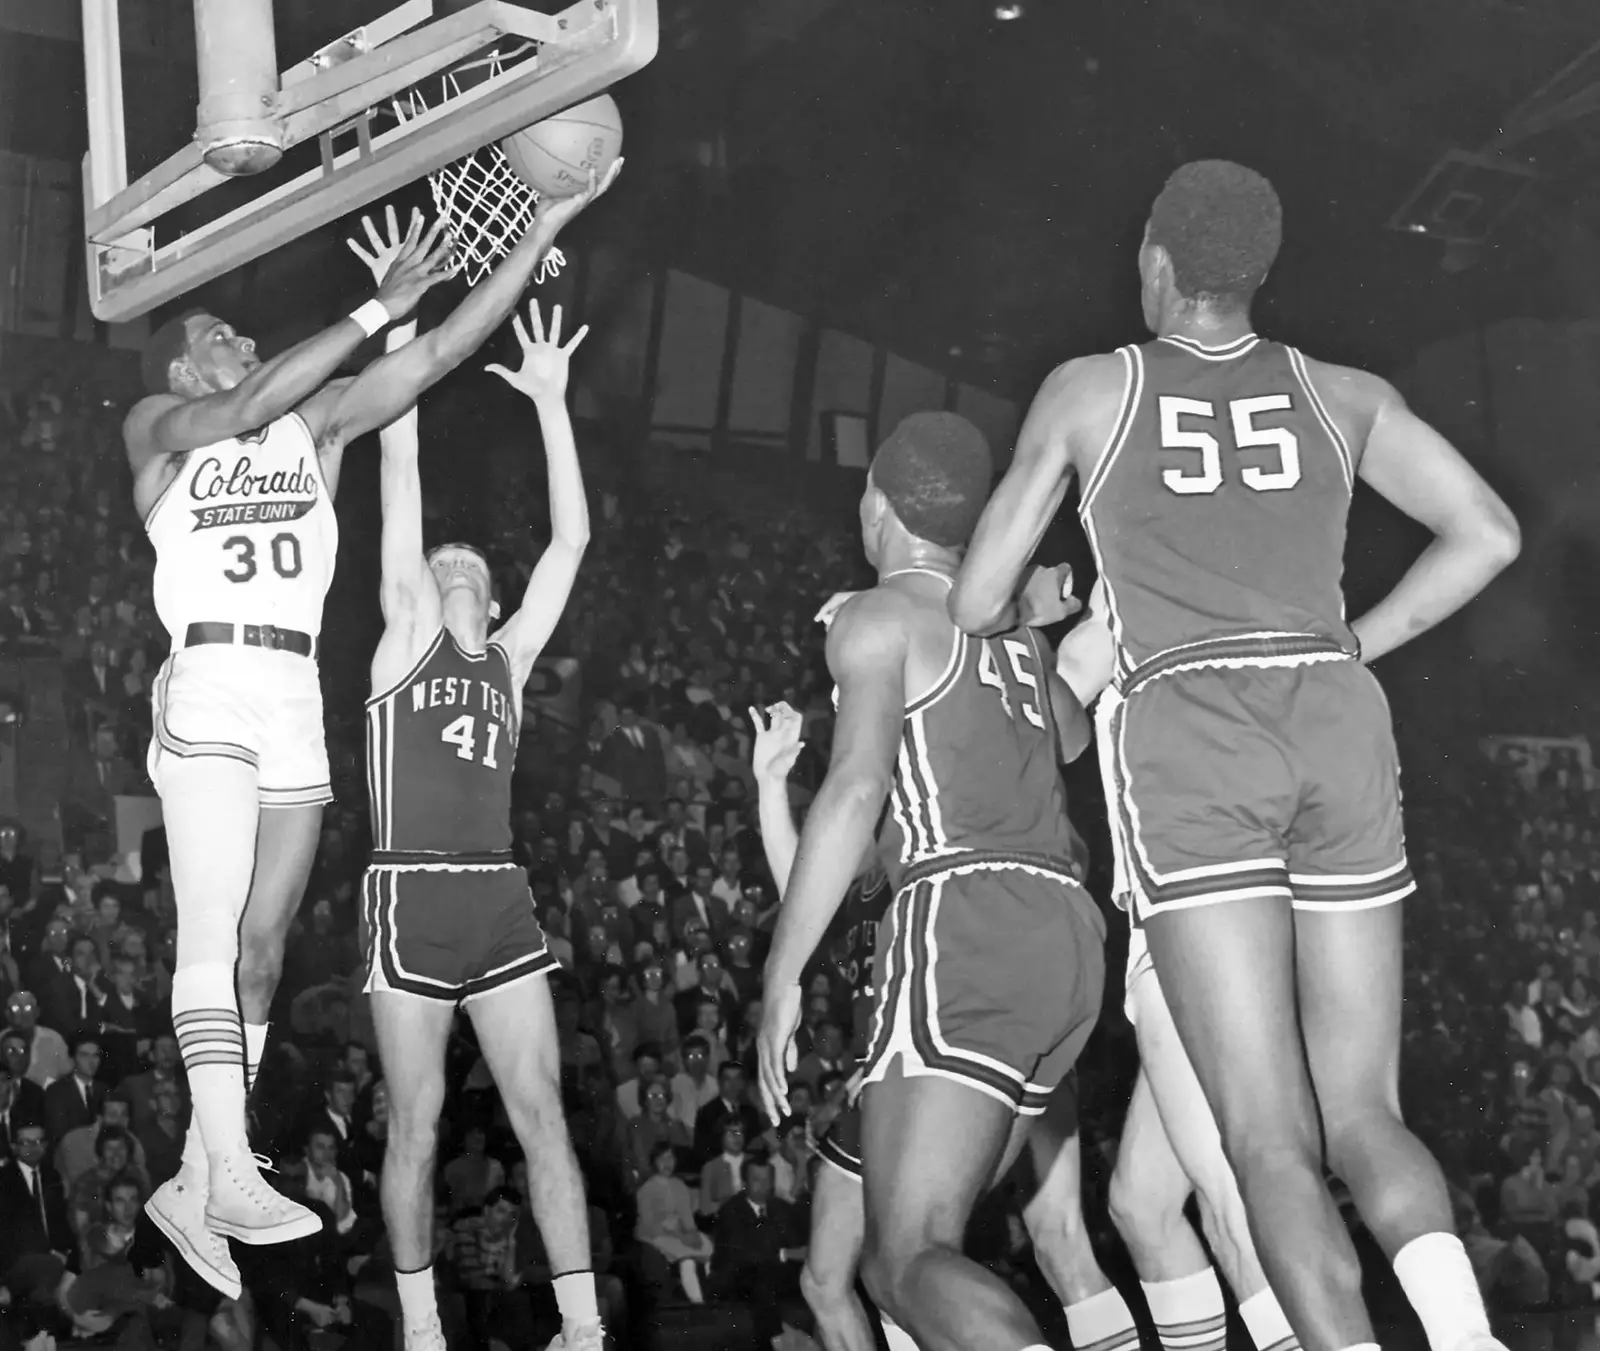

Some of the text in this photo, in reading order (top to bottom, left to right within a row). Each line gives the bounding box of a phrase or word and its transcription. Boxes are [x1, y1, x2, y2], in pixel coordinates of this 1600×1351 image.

[1159, 395, 1300, 493] 55
[190, 456, 317, 501] Colorado
[201, 503, 296, 526] STATE UNIV
[222, 532, 302, 583] 30
[412, 677, 472, 712] WEST
[978, 638, 1045, 730] 45
[441, 714, 499, 769] 41
